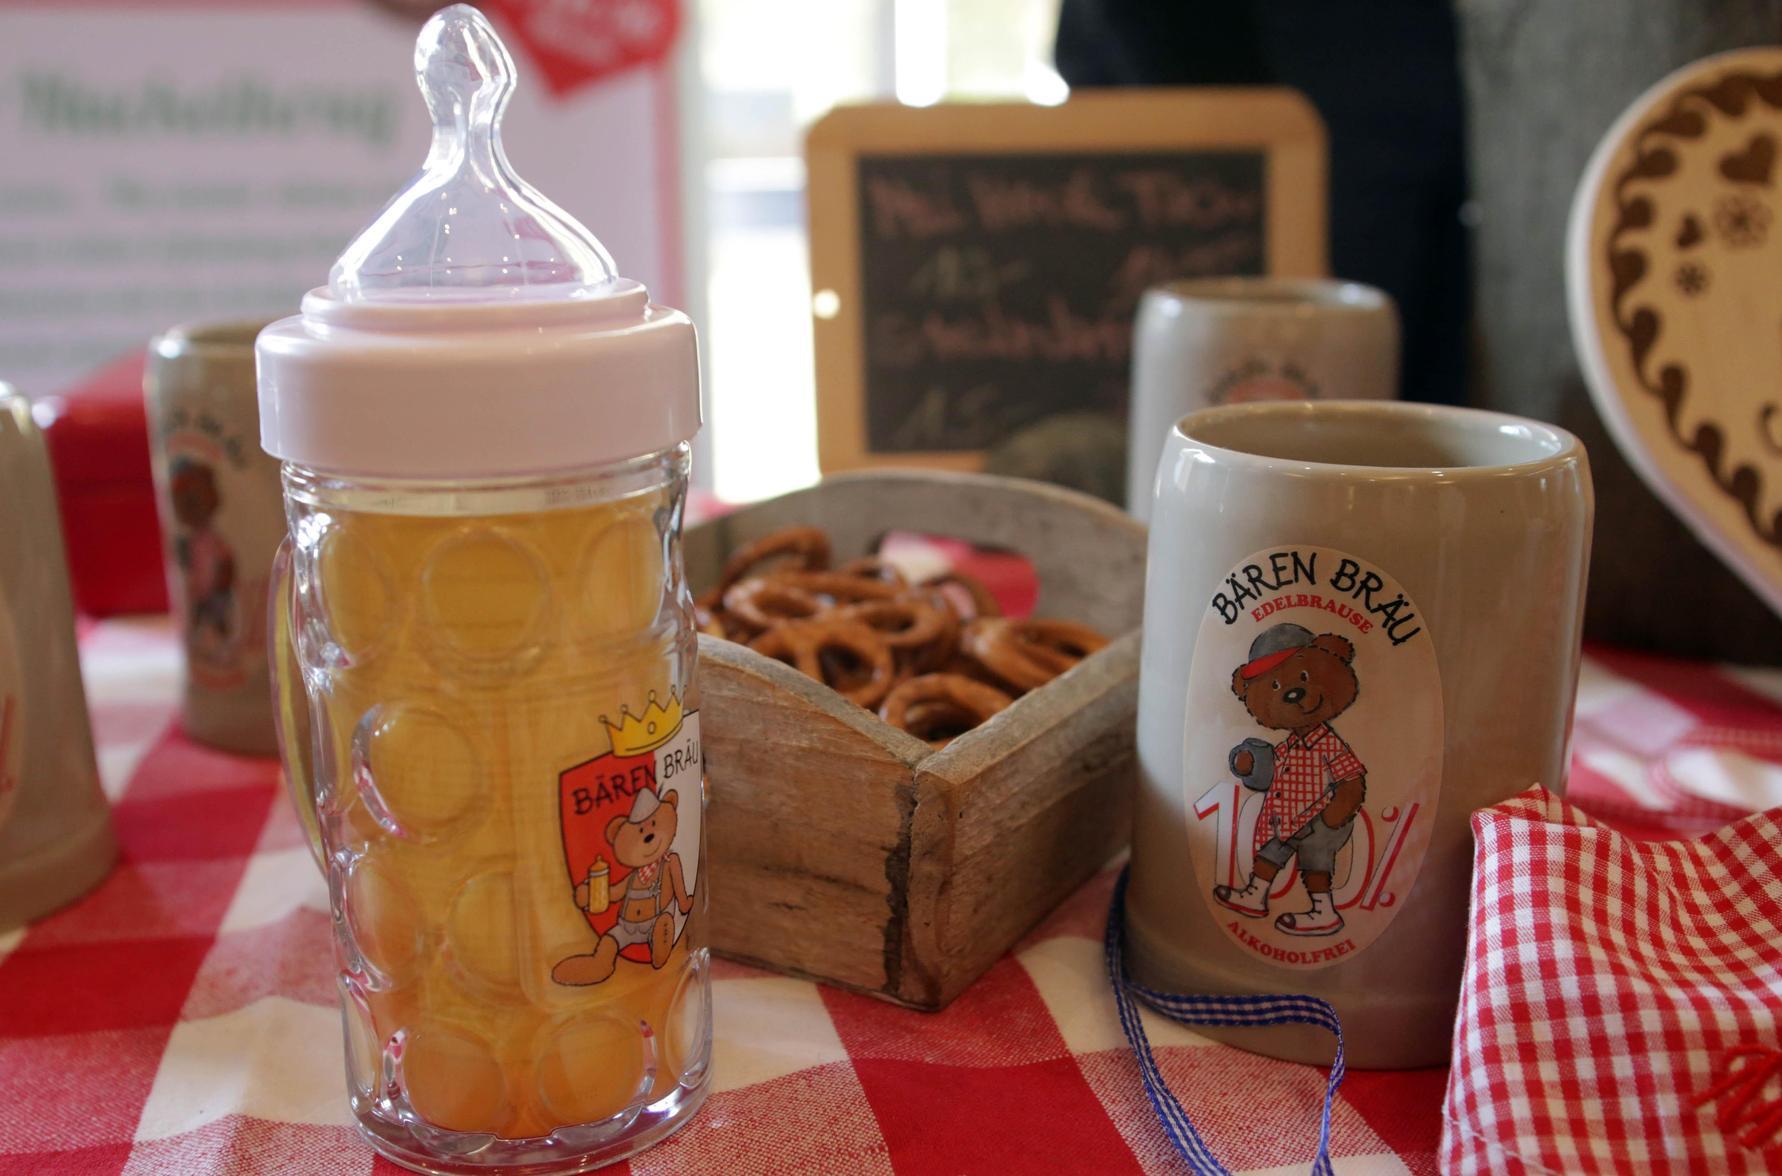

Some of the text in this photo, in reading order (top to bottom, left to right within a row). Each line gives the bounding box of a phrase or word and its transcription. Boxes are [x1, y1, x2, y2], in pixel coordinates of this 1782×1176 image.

[1212, 551, 1421, 646] BÄREN BRÄU
[1251, 593, 1374, 634] EDELBRAUSE
[572, 738, 699, 815] BÄREN BRÄU
[1227, 921, 1356, 964] ALKOHOLFREI
